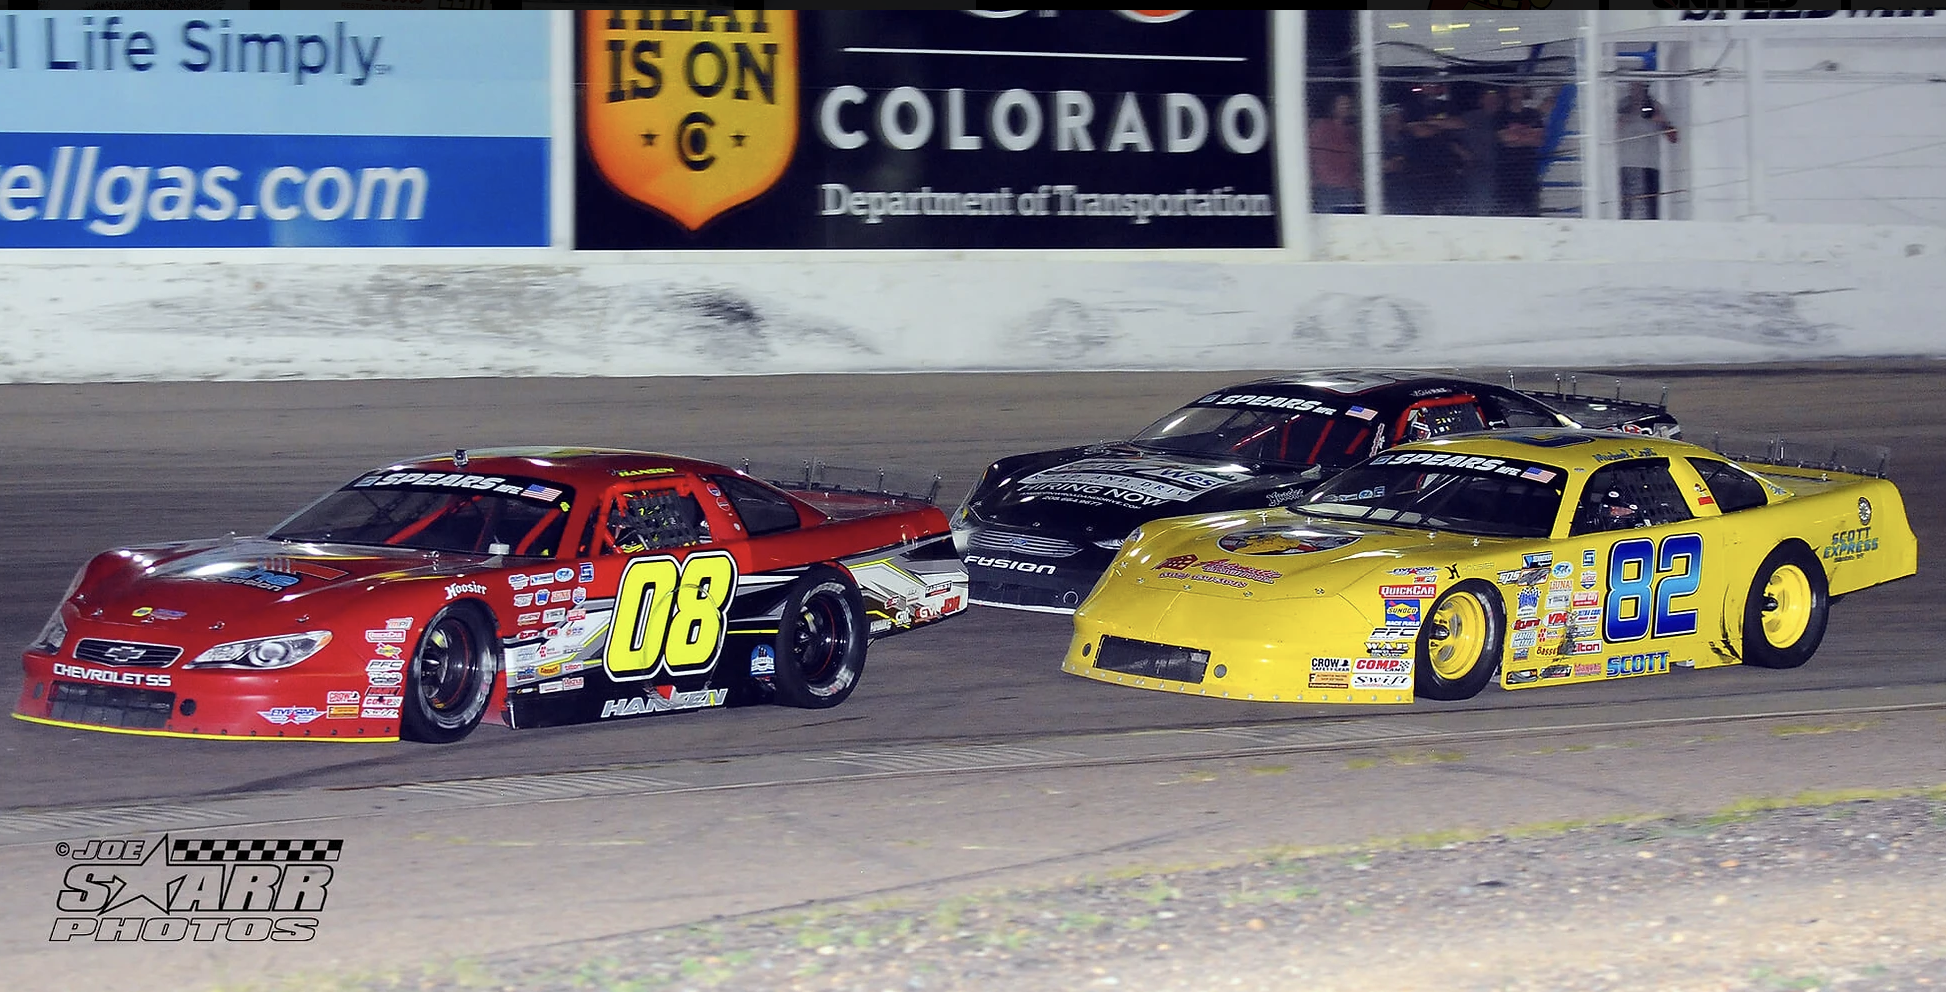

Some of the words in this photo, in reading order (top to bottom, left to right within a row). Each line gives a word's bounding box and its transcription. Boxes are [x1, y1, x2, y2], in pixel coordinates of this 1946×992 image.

[45, 16, 155, 72] Life
[606, 40, 663, 103] IS
[683, 41, 778, 104] ON
[818, 84, 1270, 154] COLORADO
[820, 184, 1014, 223] Department
[1017, 185, 1051, 216] of
[1054, 185, 1274, 224] Transportation
[1216, 394, 1322, 411] SPEARS
[1387, 453, 1505, 471] SPEARS
[374, 473, 506, 490] SPEARS
[1017, 483, 1104, 494] HIRING
[1104, 488, 1170, 506] NOW
[1832, 527, 1871, 545] SCOTT
[1823, 538, 1878, 559] EXPRESS
[444, 581, 488, 600] Hoosier
[1602, 532, 1703, 644] 82
[603, 551, 738, 682] 08
[1372, 628, 1418, 636] PFC
[1311, 658, 1340, 668] CROW
[1356, 660, 1399, 670] COMP
[1606, 651, 1670, 677] SCOTT
[53, 663, 145, 685] CHEVROLET
[145, 675, 171, 686] SS
[1354, 676, 1408, 685] Swift
